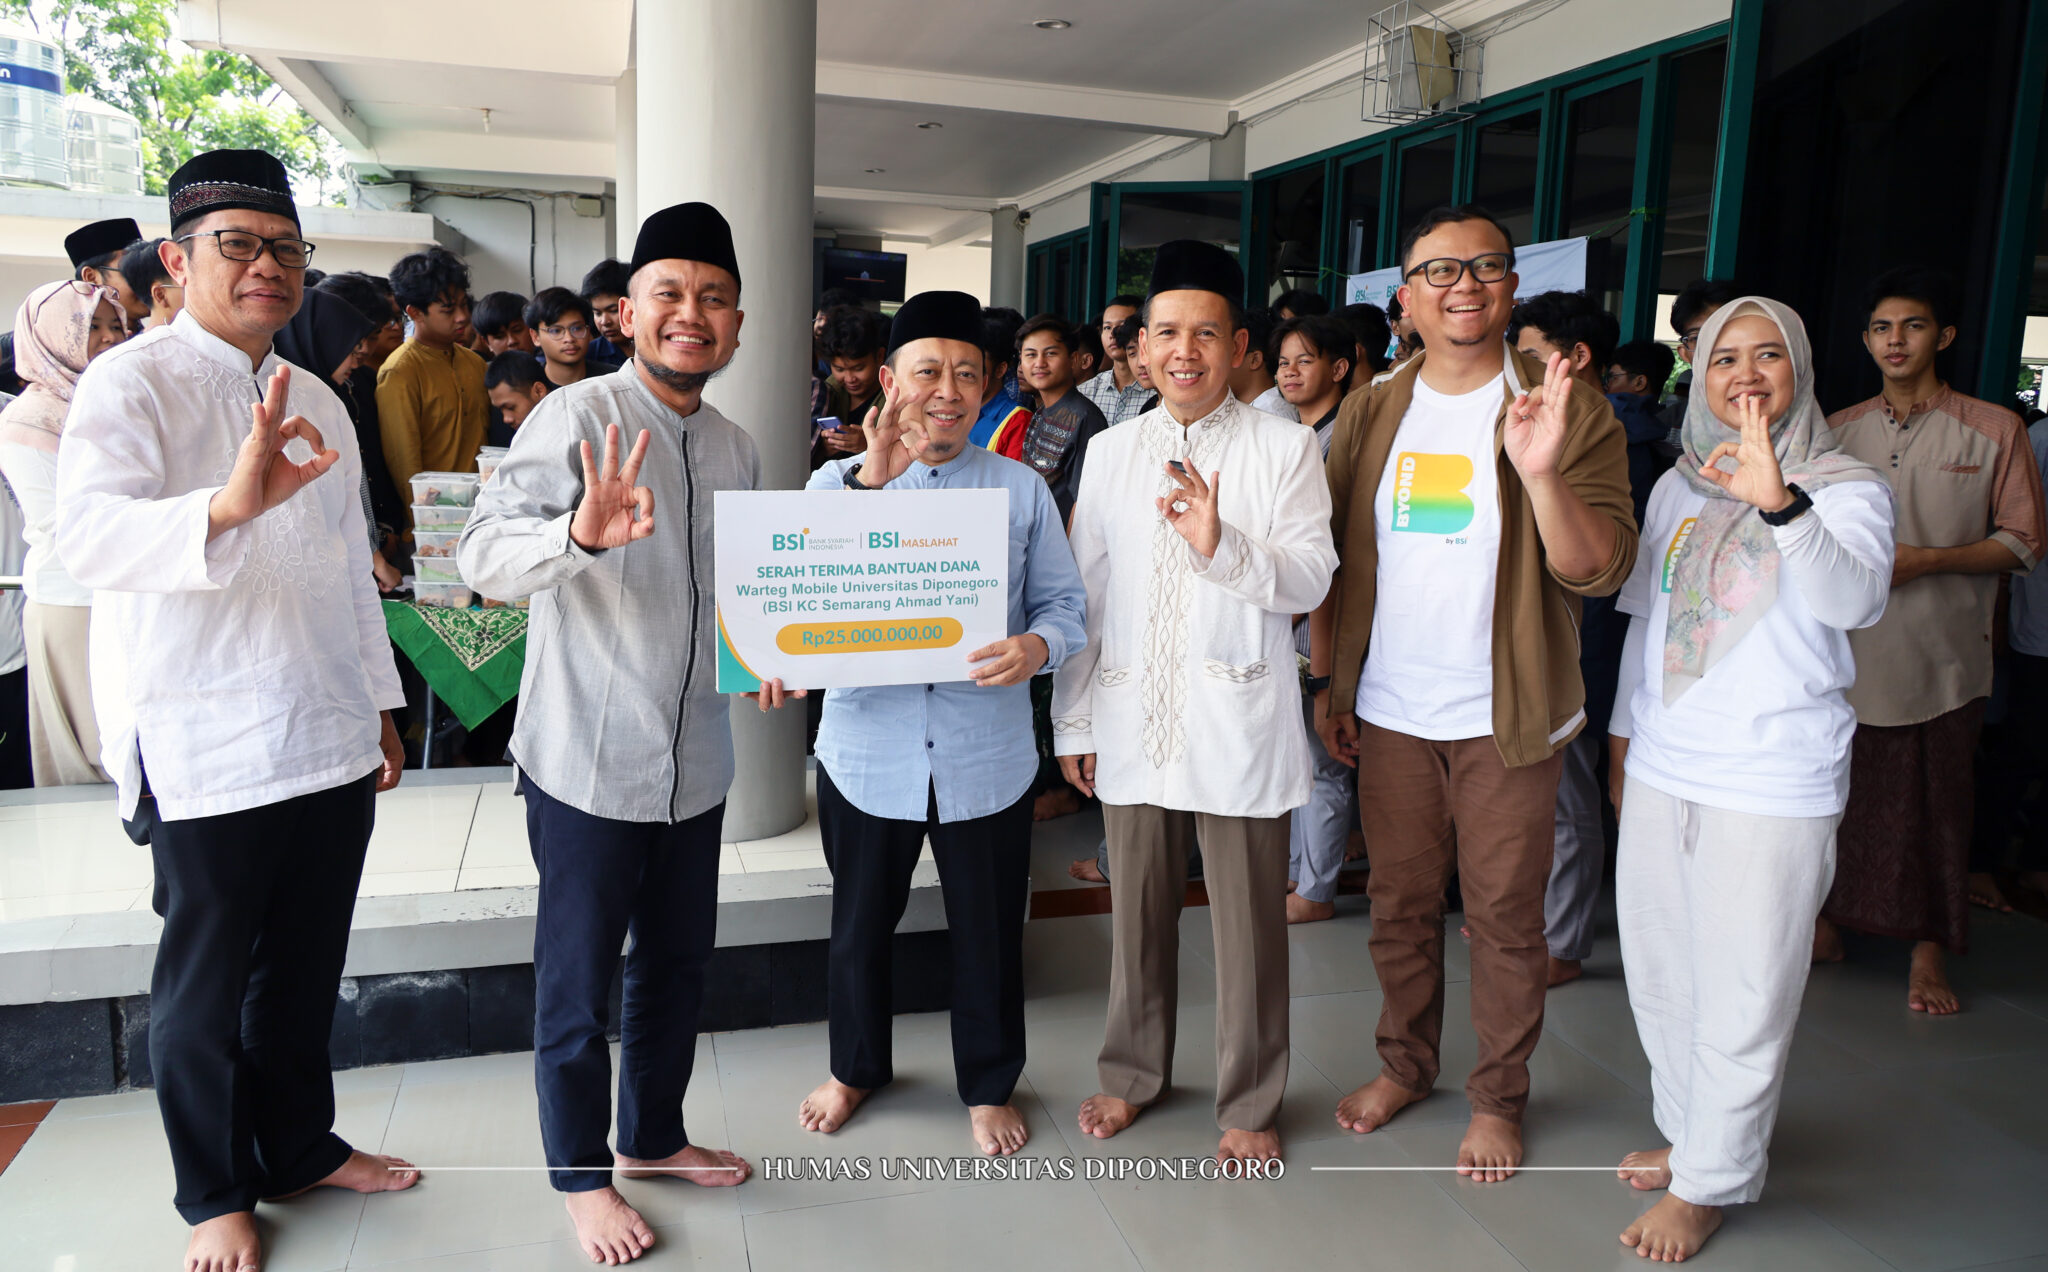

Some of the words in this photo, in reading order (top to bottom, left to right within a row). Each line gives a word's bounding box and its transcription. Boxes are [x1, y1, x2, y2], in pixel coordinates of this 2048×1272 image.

[1395, 457, 1416, 528] BYOND
[772, 532, 806, 551] BSI
[868, 532, 899, 548] BSI
[902, 538, 959, 548] MASLAHAT
[1445, 537, 1455, 545] by
[757, 566, 805, 578] SERAH
[809, 564, 864, 577] TERIMA
[868, 561, 937, 575] BANTUAN
[940, 560, 981, 573] DANA
[736, 584, 787, 598] Warteg
[792, 582, 838, 595] Mobile
[842, 580, 918, 593] Universitas
[922, 578, 999, 592] Diponegoro
[763, 600, 792, 615] (BSI
[797, 599, 818, 612] KC
[822, 598, 891, 611] Semarang
[895, 595, 942, 608] Ahmad
[946, 593, 979, 607] Yani)
[802, 625, 943, 648] Rp25.000.000,00
